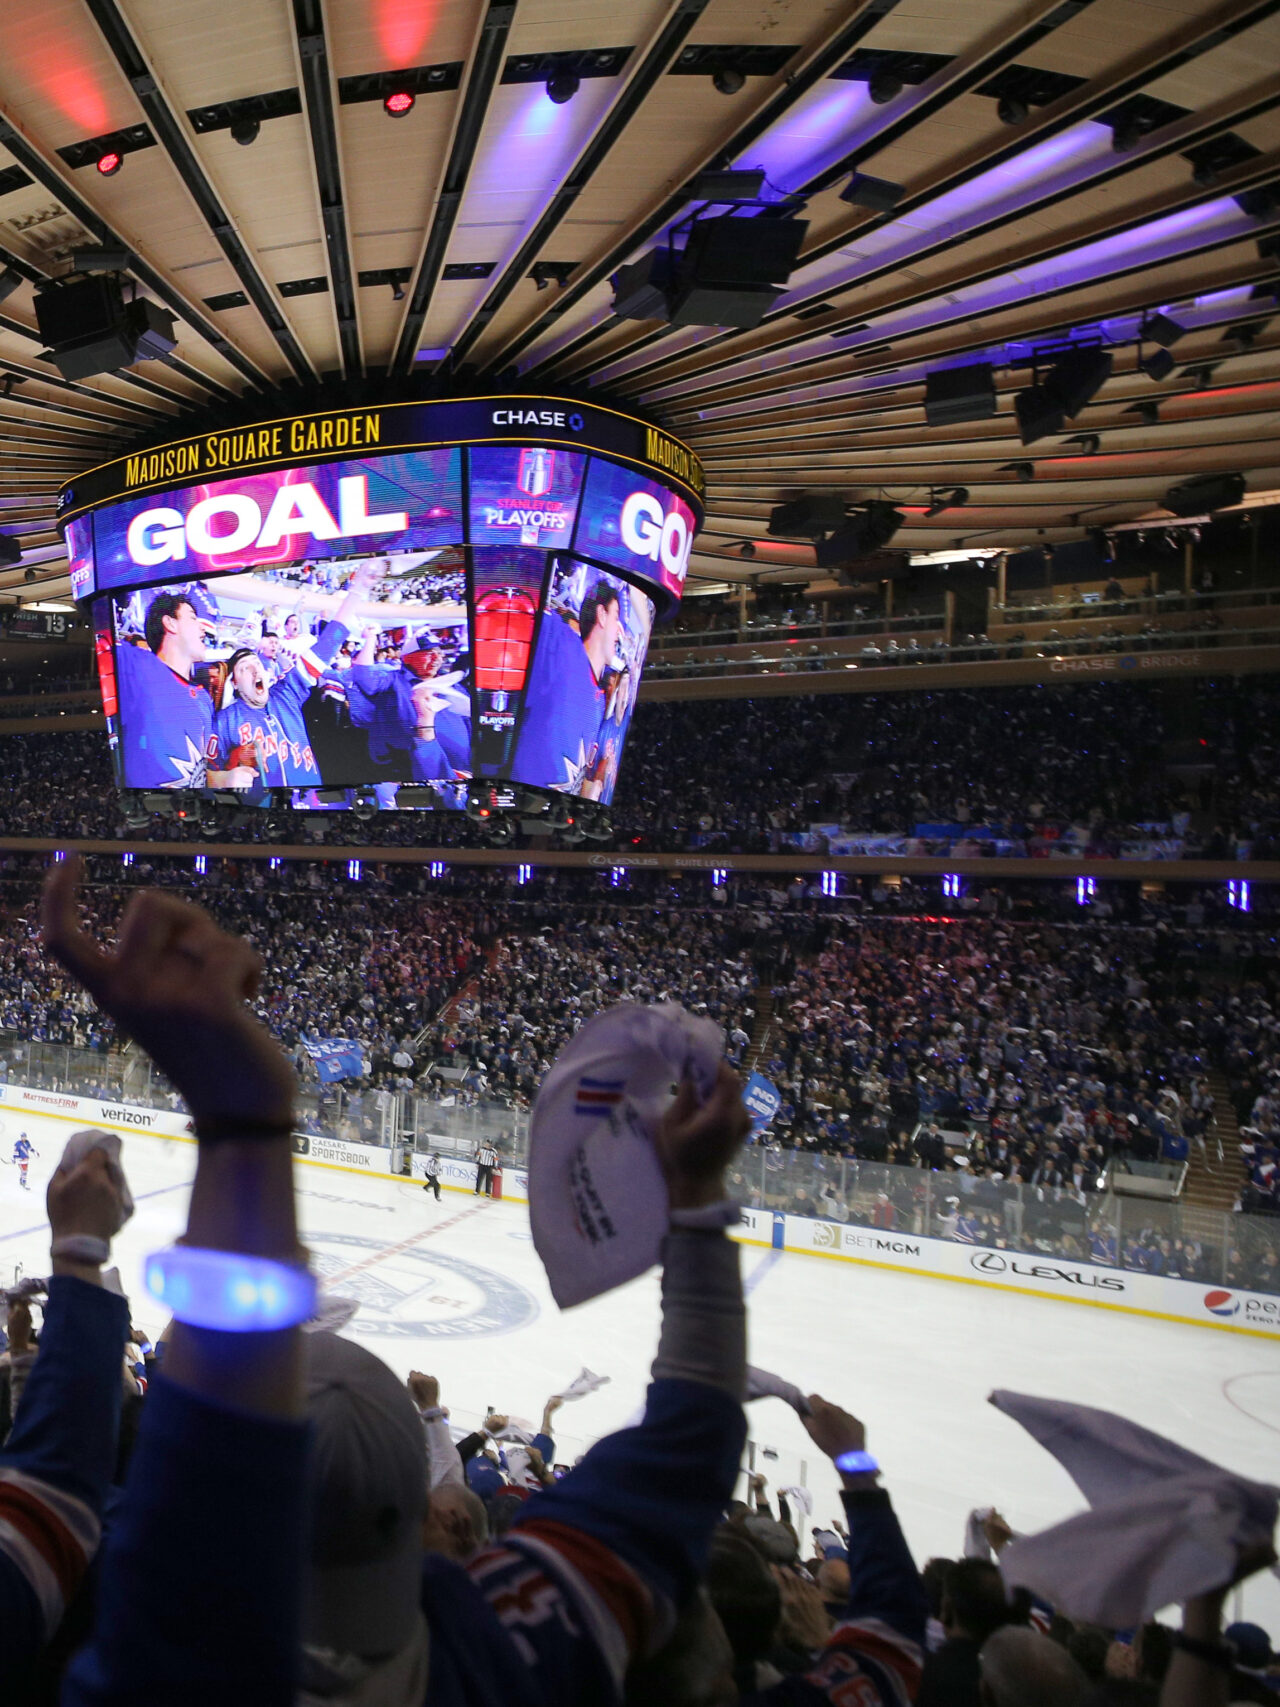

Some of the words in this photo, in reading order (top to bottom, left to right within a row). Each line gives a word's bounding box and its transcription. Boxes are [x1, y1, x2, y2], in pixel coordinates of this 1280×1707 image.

[492, 410, 566, 426] CHASE
[126, 444, 199, 487] MADISON
[206, 427, 283, 468] SQUARE
[291, 414, 380, 452] GARDEN
[646, 428, 689, 481] MADISON
[497, 498, 544, 510] STANLEY
[127, 474, 409, 567] GOAL
[486, 508, 568, 528] PLAYOFFS
[45, 614, 65, 633] 13
[1050, 659, 1116, 672] CHASE
[1141, 654, 1201, 668] BRIDGE
[479, 716, 516, 726] PLAYOFFS
[675, 859, 702, 867] SUITE
[705, 860, 735, 868] LEVEL
[101, 1107, 151, 1126] verizon
[312, 1139, 347, 1150] CAESARS
[311, 1148, 370, 1166] SPORTSBOOK
[1012, 1261, 1125, 1291] LEXUS
